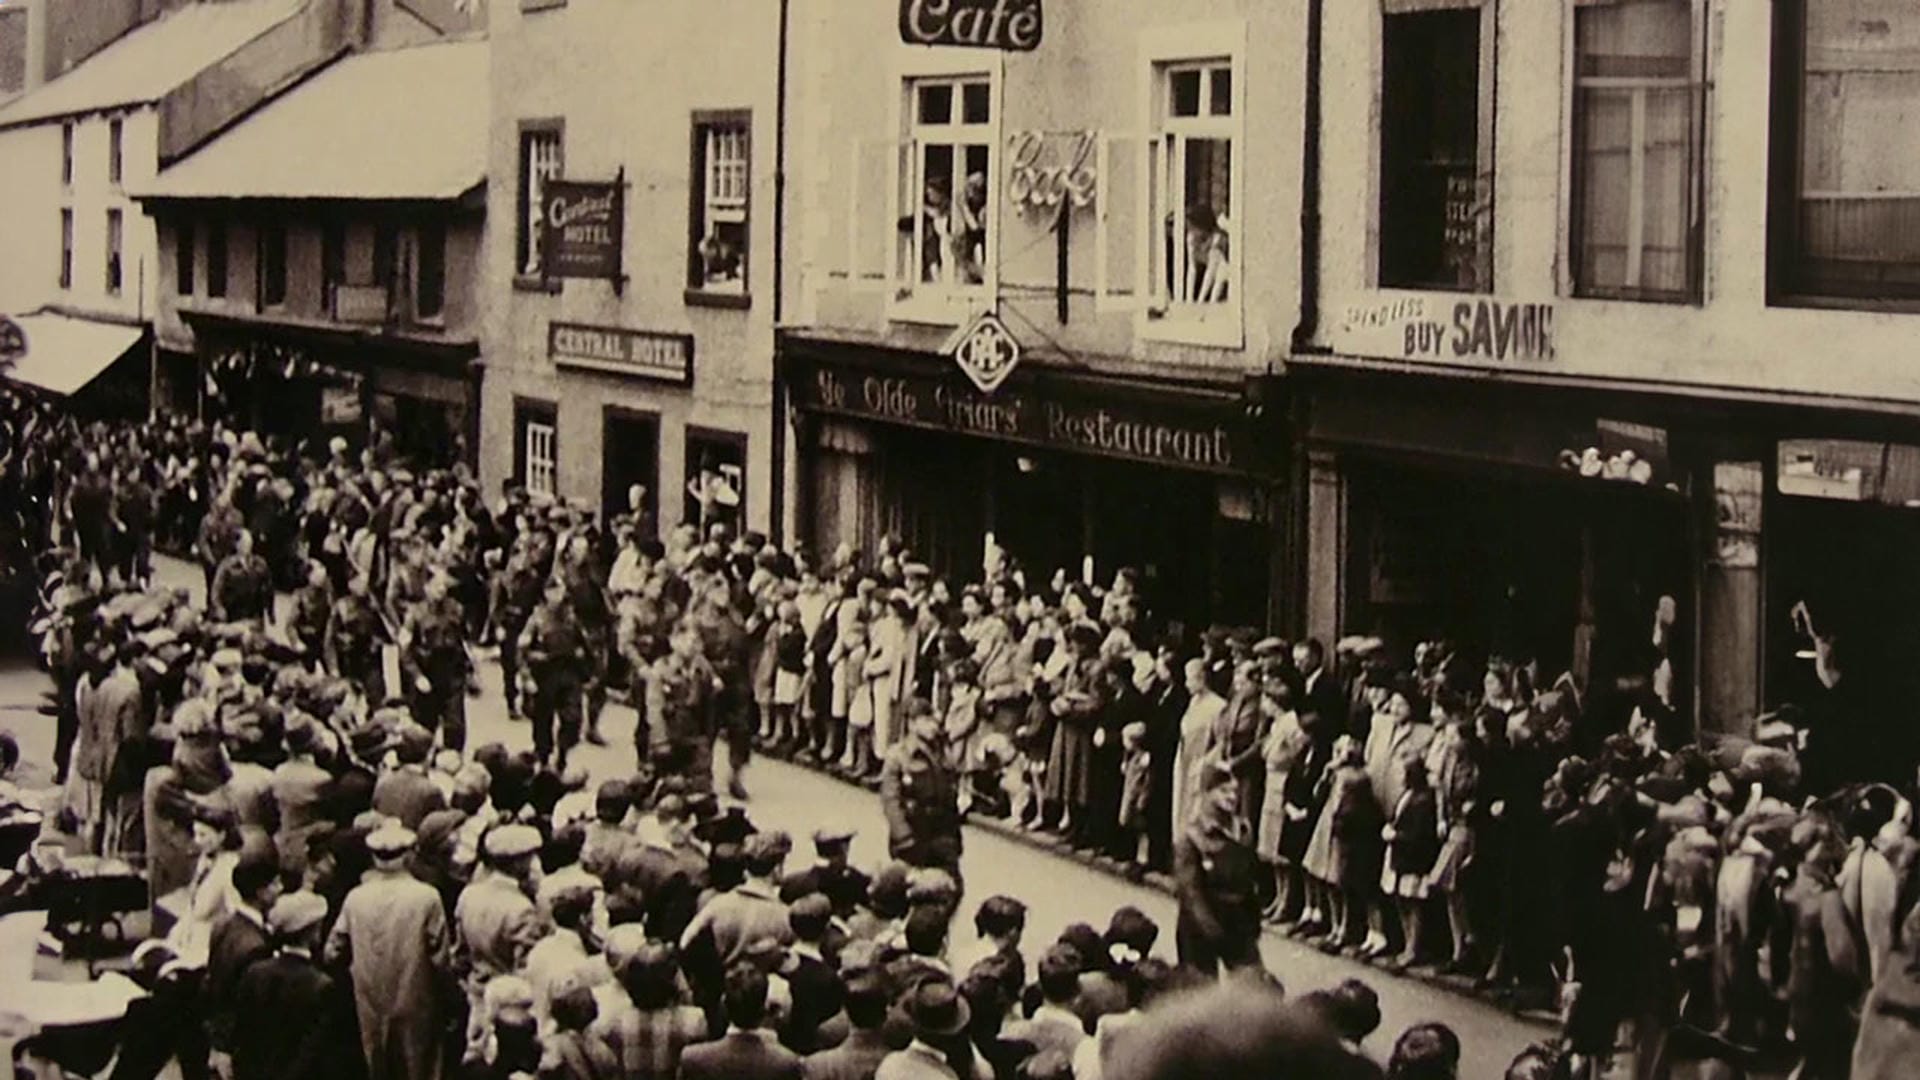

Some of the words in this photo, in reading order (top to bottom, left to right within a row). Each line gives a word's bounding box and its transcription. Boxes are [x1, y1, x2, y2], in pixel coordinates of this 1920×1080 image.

[908, 0, 1038, 46] Café
[564, 224, 612, 245] HOTEL
[554, 328, 624, 359] CENTRAL
[631, 336, 687, 367] HOTEL
[1403, 321, 1446, 357] BUY
[818, 369, 846, 407] Ye
[863, 375, 917, 420] Olde
[1046, 401, 1232, 465] Restaurant
